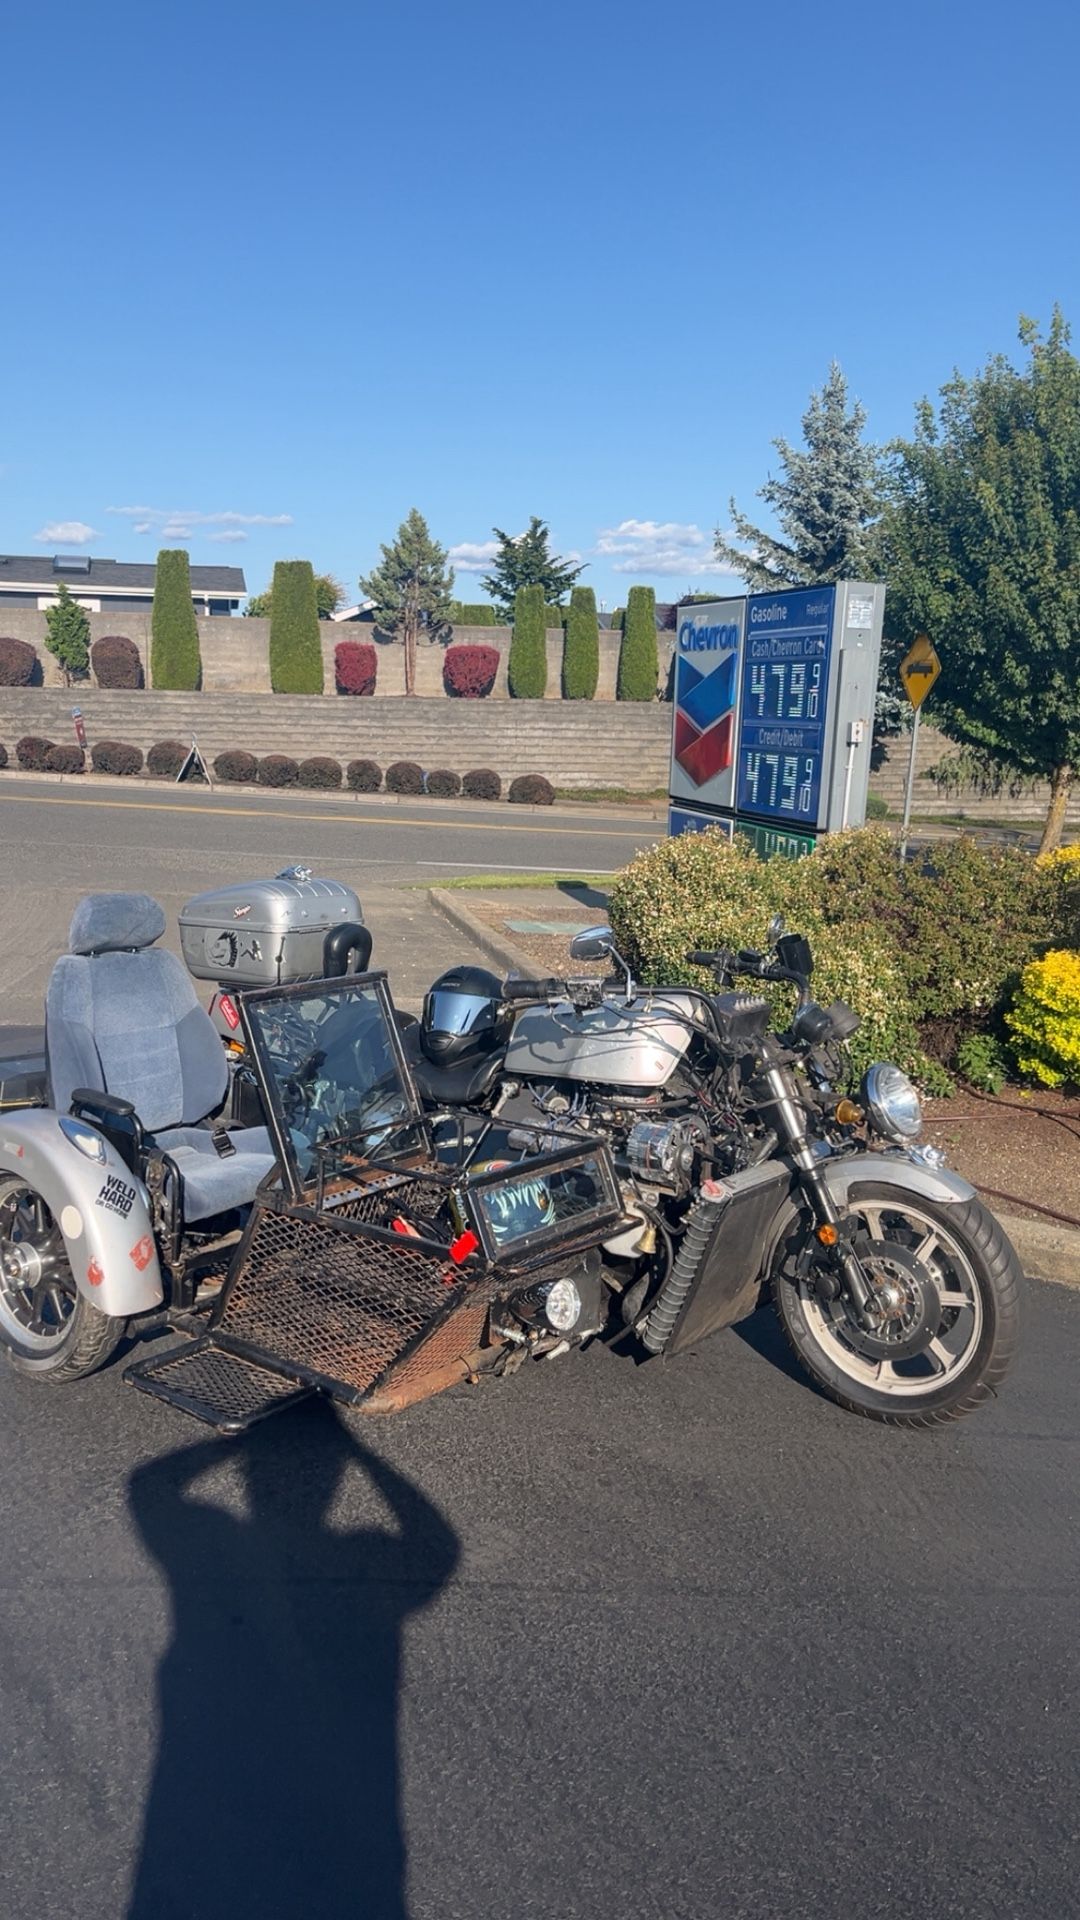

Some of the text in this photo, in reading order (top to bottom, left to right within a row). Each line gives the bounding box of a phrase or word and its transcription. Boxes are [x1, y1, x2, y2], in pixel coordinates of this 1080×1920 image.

[751, 603, 788, 624] Gasoline
[806, 603, 830, 617] Regular
[679, 619, 738, 652] Chevron
[751, 637, 802, 658] Cash/Chevron
[758, 728, 804, 747] Credit/Debit
[98, 1185, 133, 1213] HARD
[106, 1174, 136, 1201] WELD
